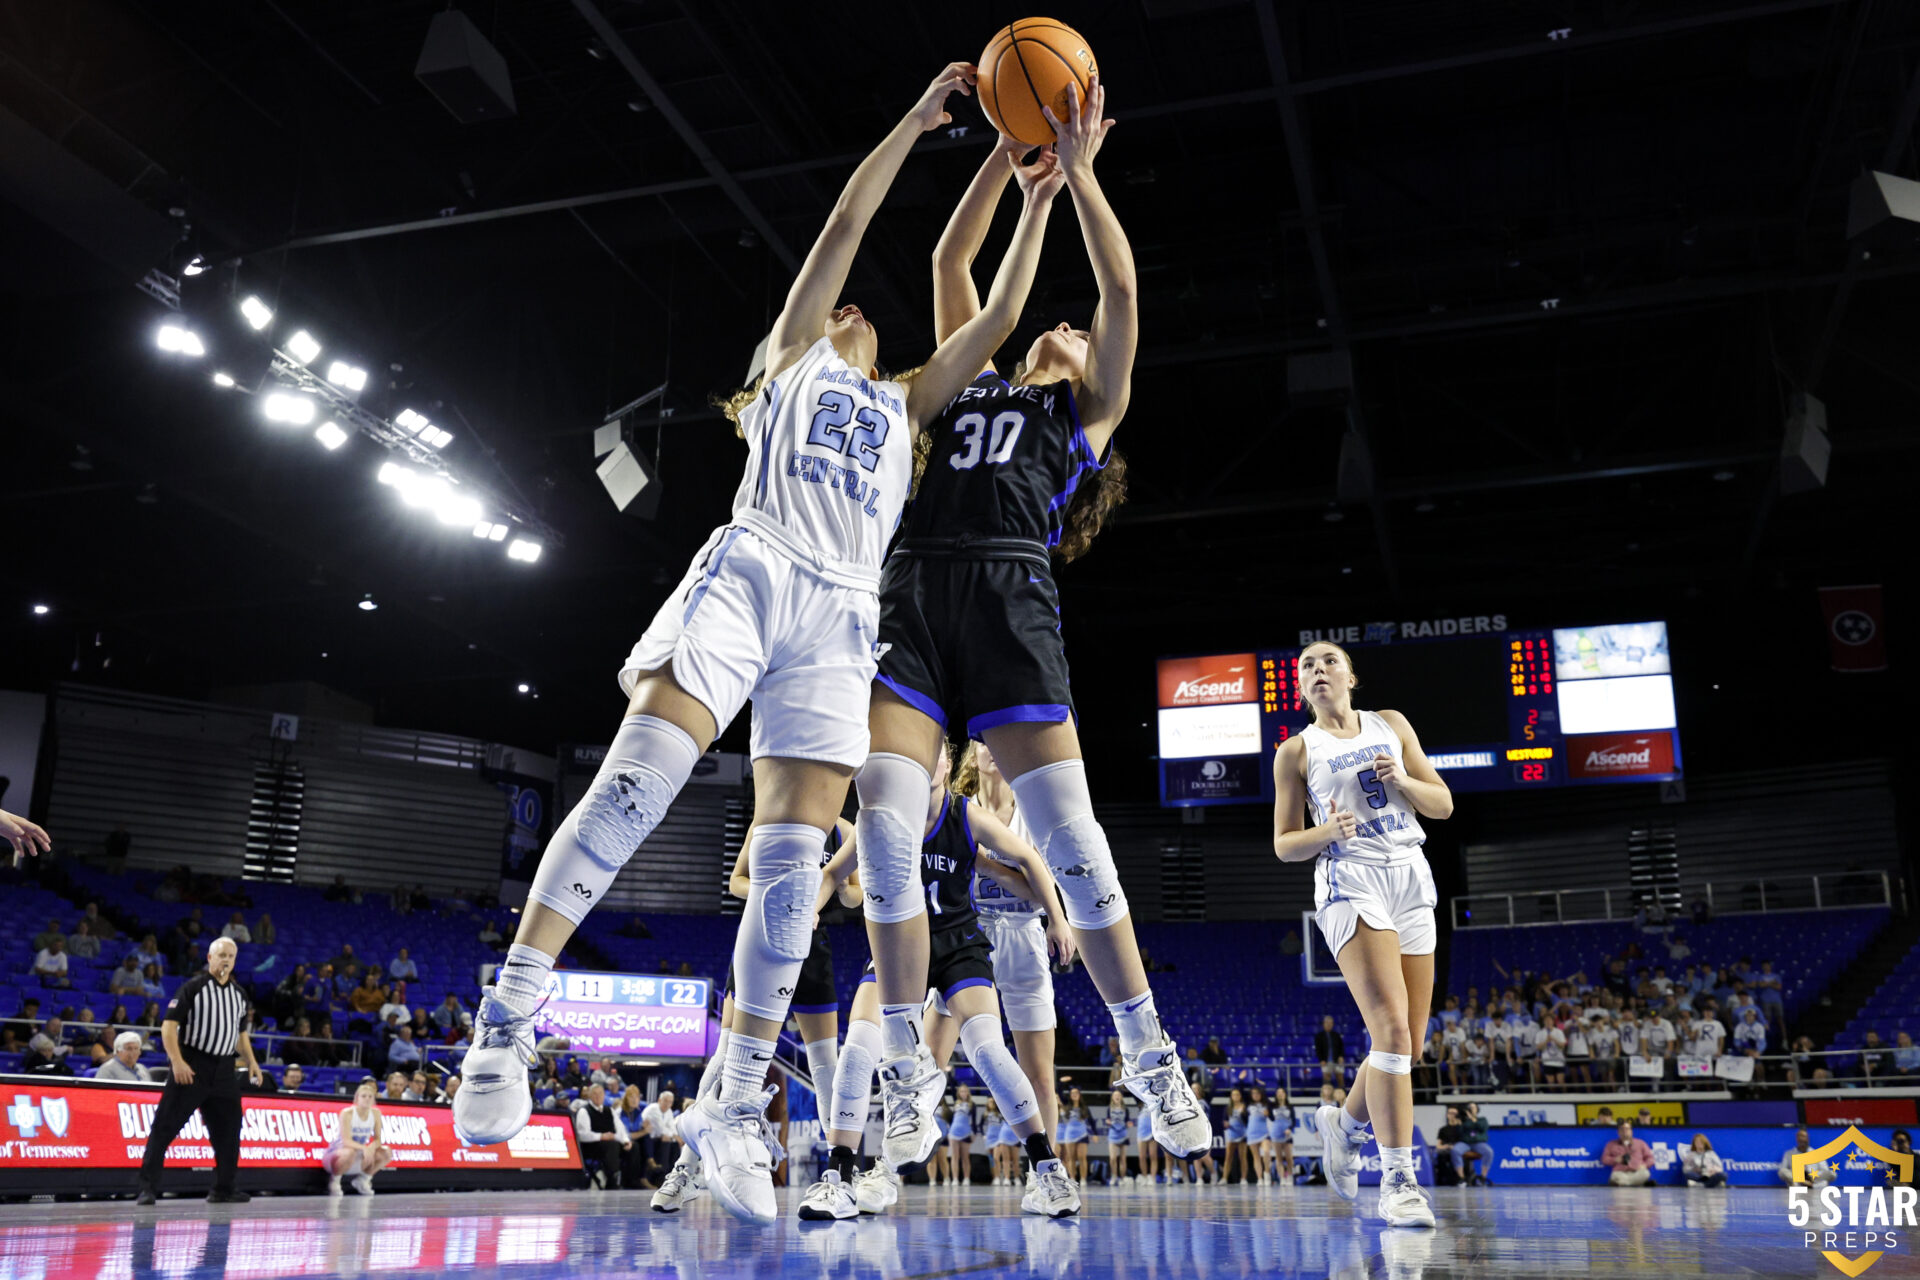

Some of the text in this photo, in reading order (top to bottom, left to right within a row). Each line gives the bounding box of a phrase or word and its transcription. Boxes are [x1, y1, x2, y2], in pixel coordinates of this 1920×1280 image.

[806, 390, 890, 474] 22
[949, 411, 1026, 471] 30
[1299, 626, 1361, 646] BLUE
[1401, 615, 1507, 638] RAIDERS
[1174, 677, 1245, 698] Ascend
[1528, 709, 1539, 725] 2
[1278, 725, 1289, 741] 3
[1523, 725, 1535, 740] 5
[1327, 744, 1394, 773] MCMINN
[1428, 752, 1494, 768] BASKETBALL
[1506, 747, 1553, 761] WESTVIEW
[1585, 749, 1651, 766] Ascend
[1522, 763, 1544, 780] 22
[1357, 768, 1388, 810] 5
[581, 980, 600, 997] 11
[671, 984, 698, 1005] 22
[1521, 1034, 1532, 1048] L
[1623, 1025, 1633, 1043] R
[1700, 1024, 1715, 1041] R
[598, 1037, 624, 1048] your
[240, 1108, 322, 1142] ASKETBALL
[0, 1141, 90, 1158] of Tennessee
[275, 1148, 306, 1160] CENTER
[1511, 1146, 1590, 1157] On the court.
[1500, 1158, 1604, 1168] And off the court.
